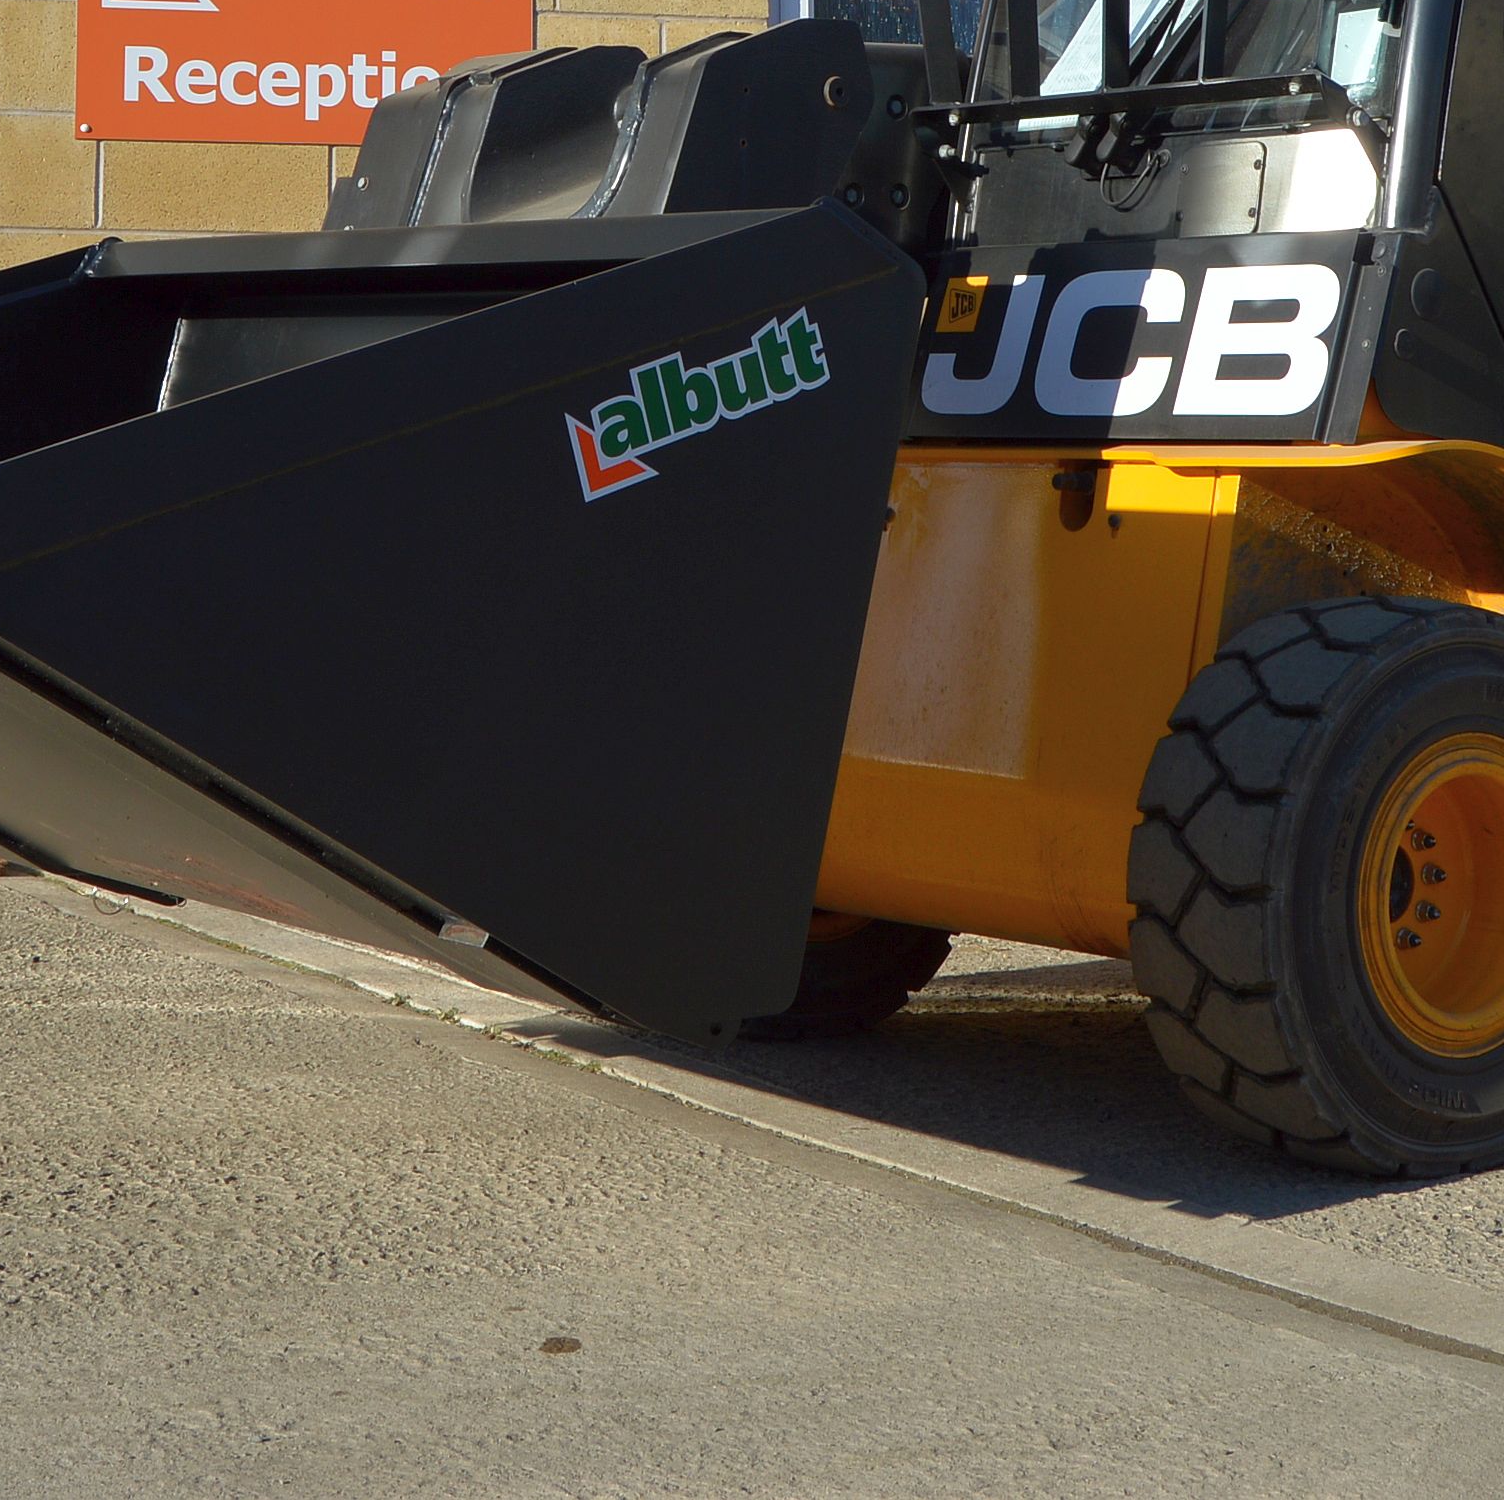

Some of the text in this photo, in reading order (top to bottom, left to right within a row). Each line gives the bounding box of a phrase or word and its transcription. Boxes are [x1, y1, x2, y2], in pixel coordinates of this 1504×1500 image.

[921, 263, 1341, 417] JCB
[951, 289, 976, 317] JCB
[593, 308, 829, 466] albutt
